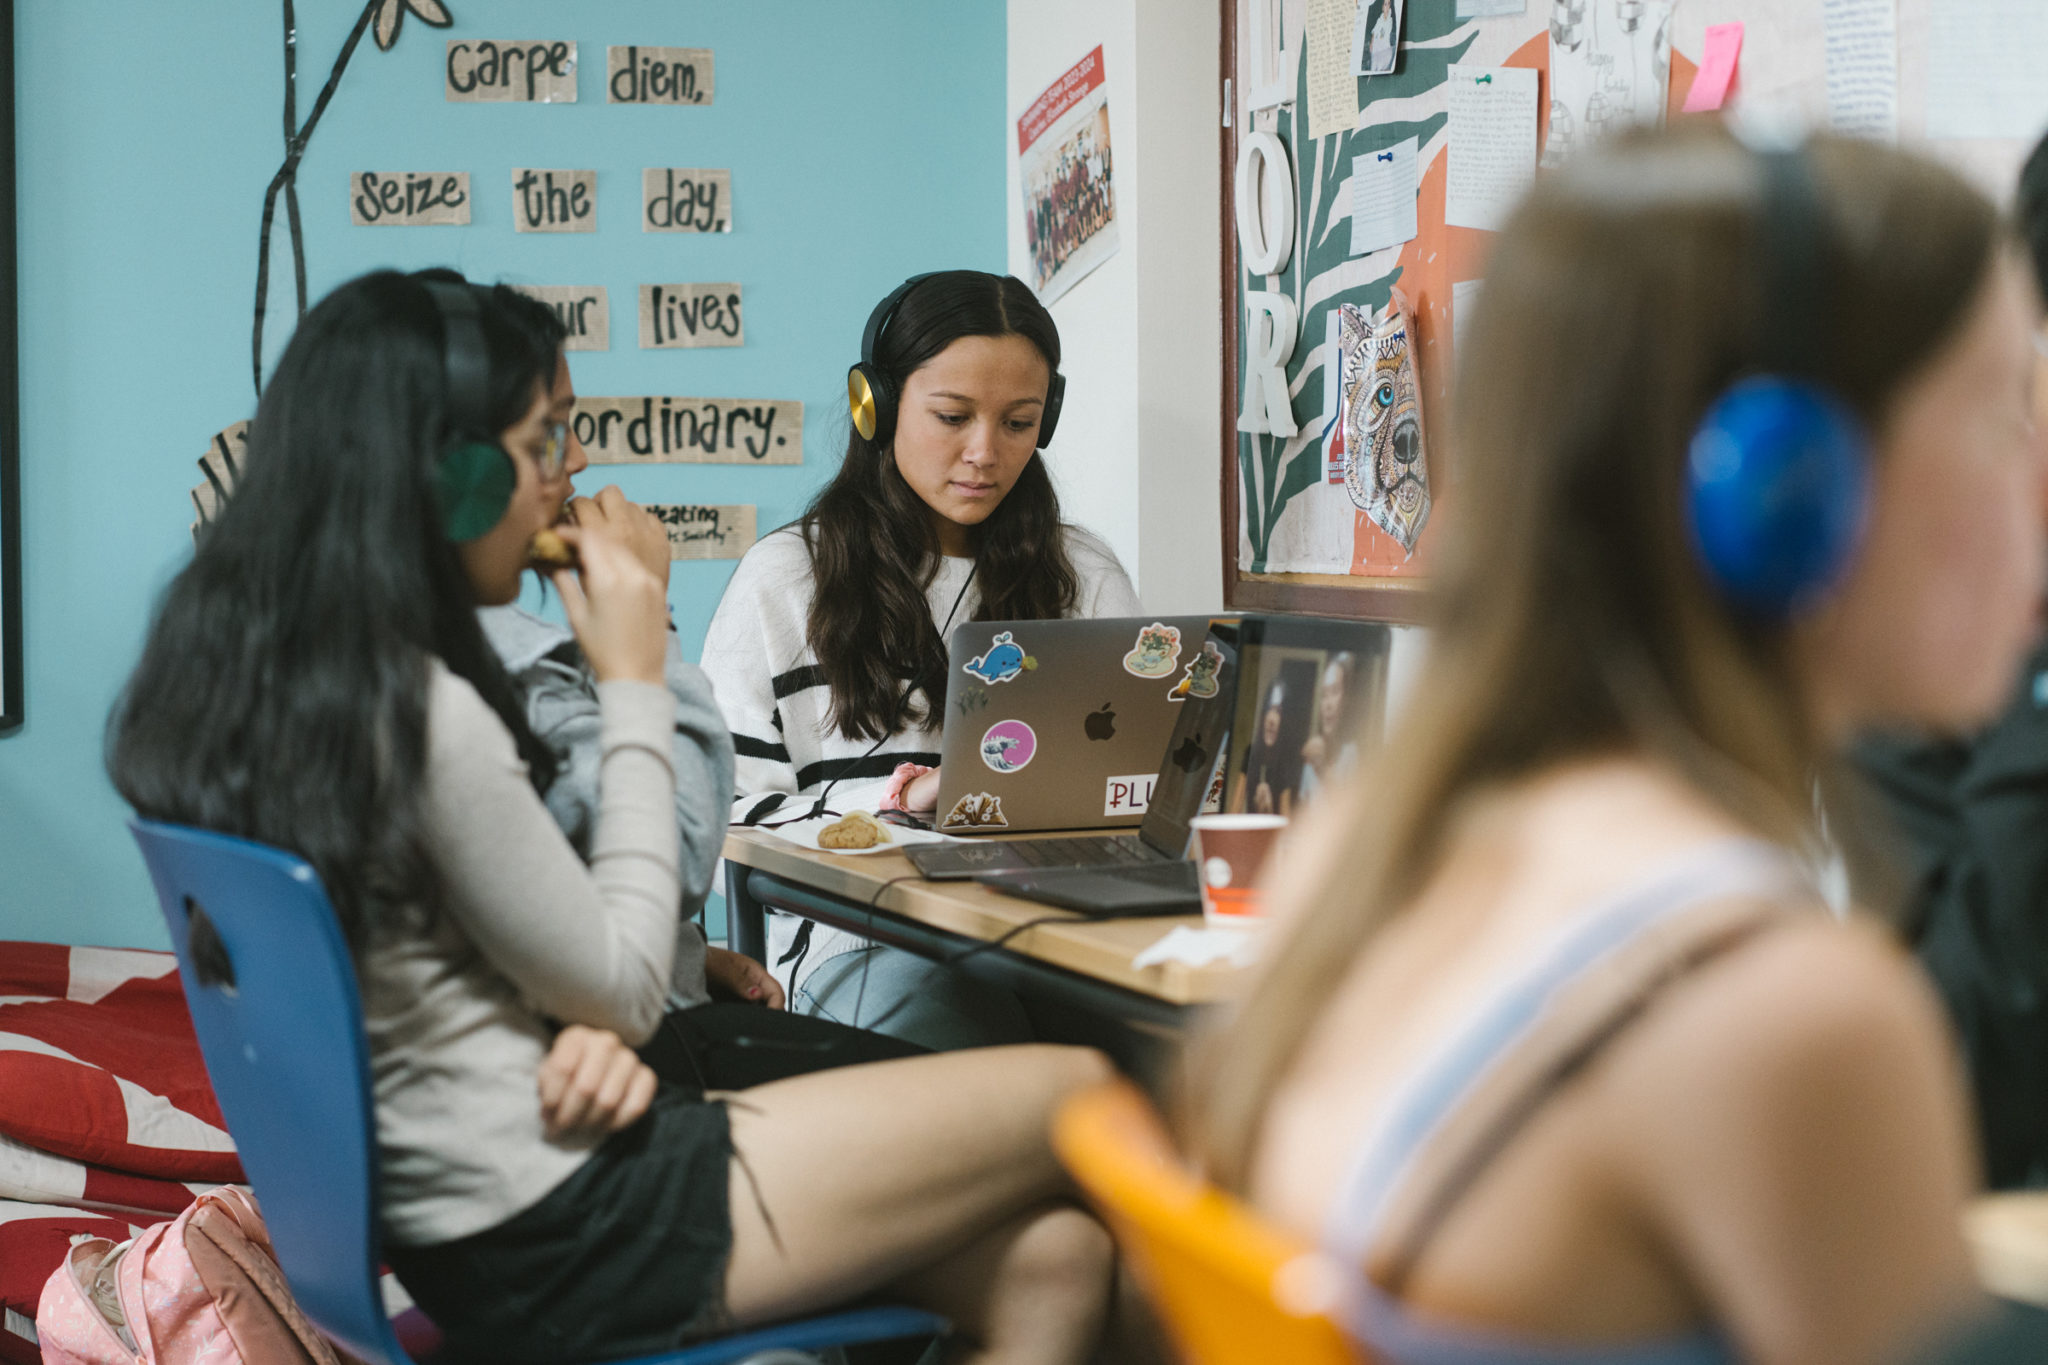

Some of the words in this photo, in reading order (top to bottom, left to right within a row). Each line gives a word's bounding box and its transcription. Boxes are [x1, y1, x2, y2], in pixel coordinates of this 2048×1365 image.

[448, 42, 569, 101] Carpe
[610, 46, 704, 102] diem,
[355, 171, 465, 223] Seize
[515, 170, 591, 227] the
[646, 168, 727, 232] day,
[554, 296, 597, 336] ur
[651, 286, 741, 344] lives
